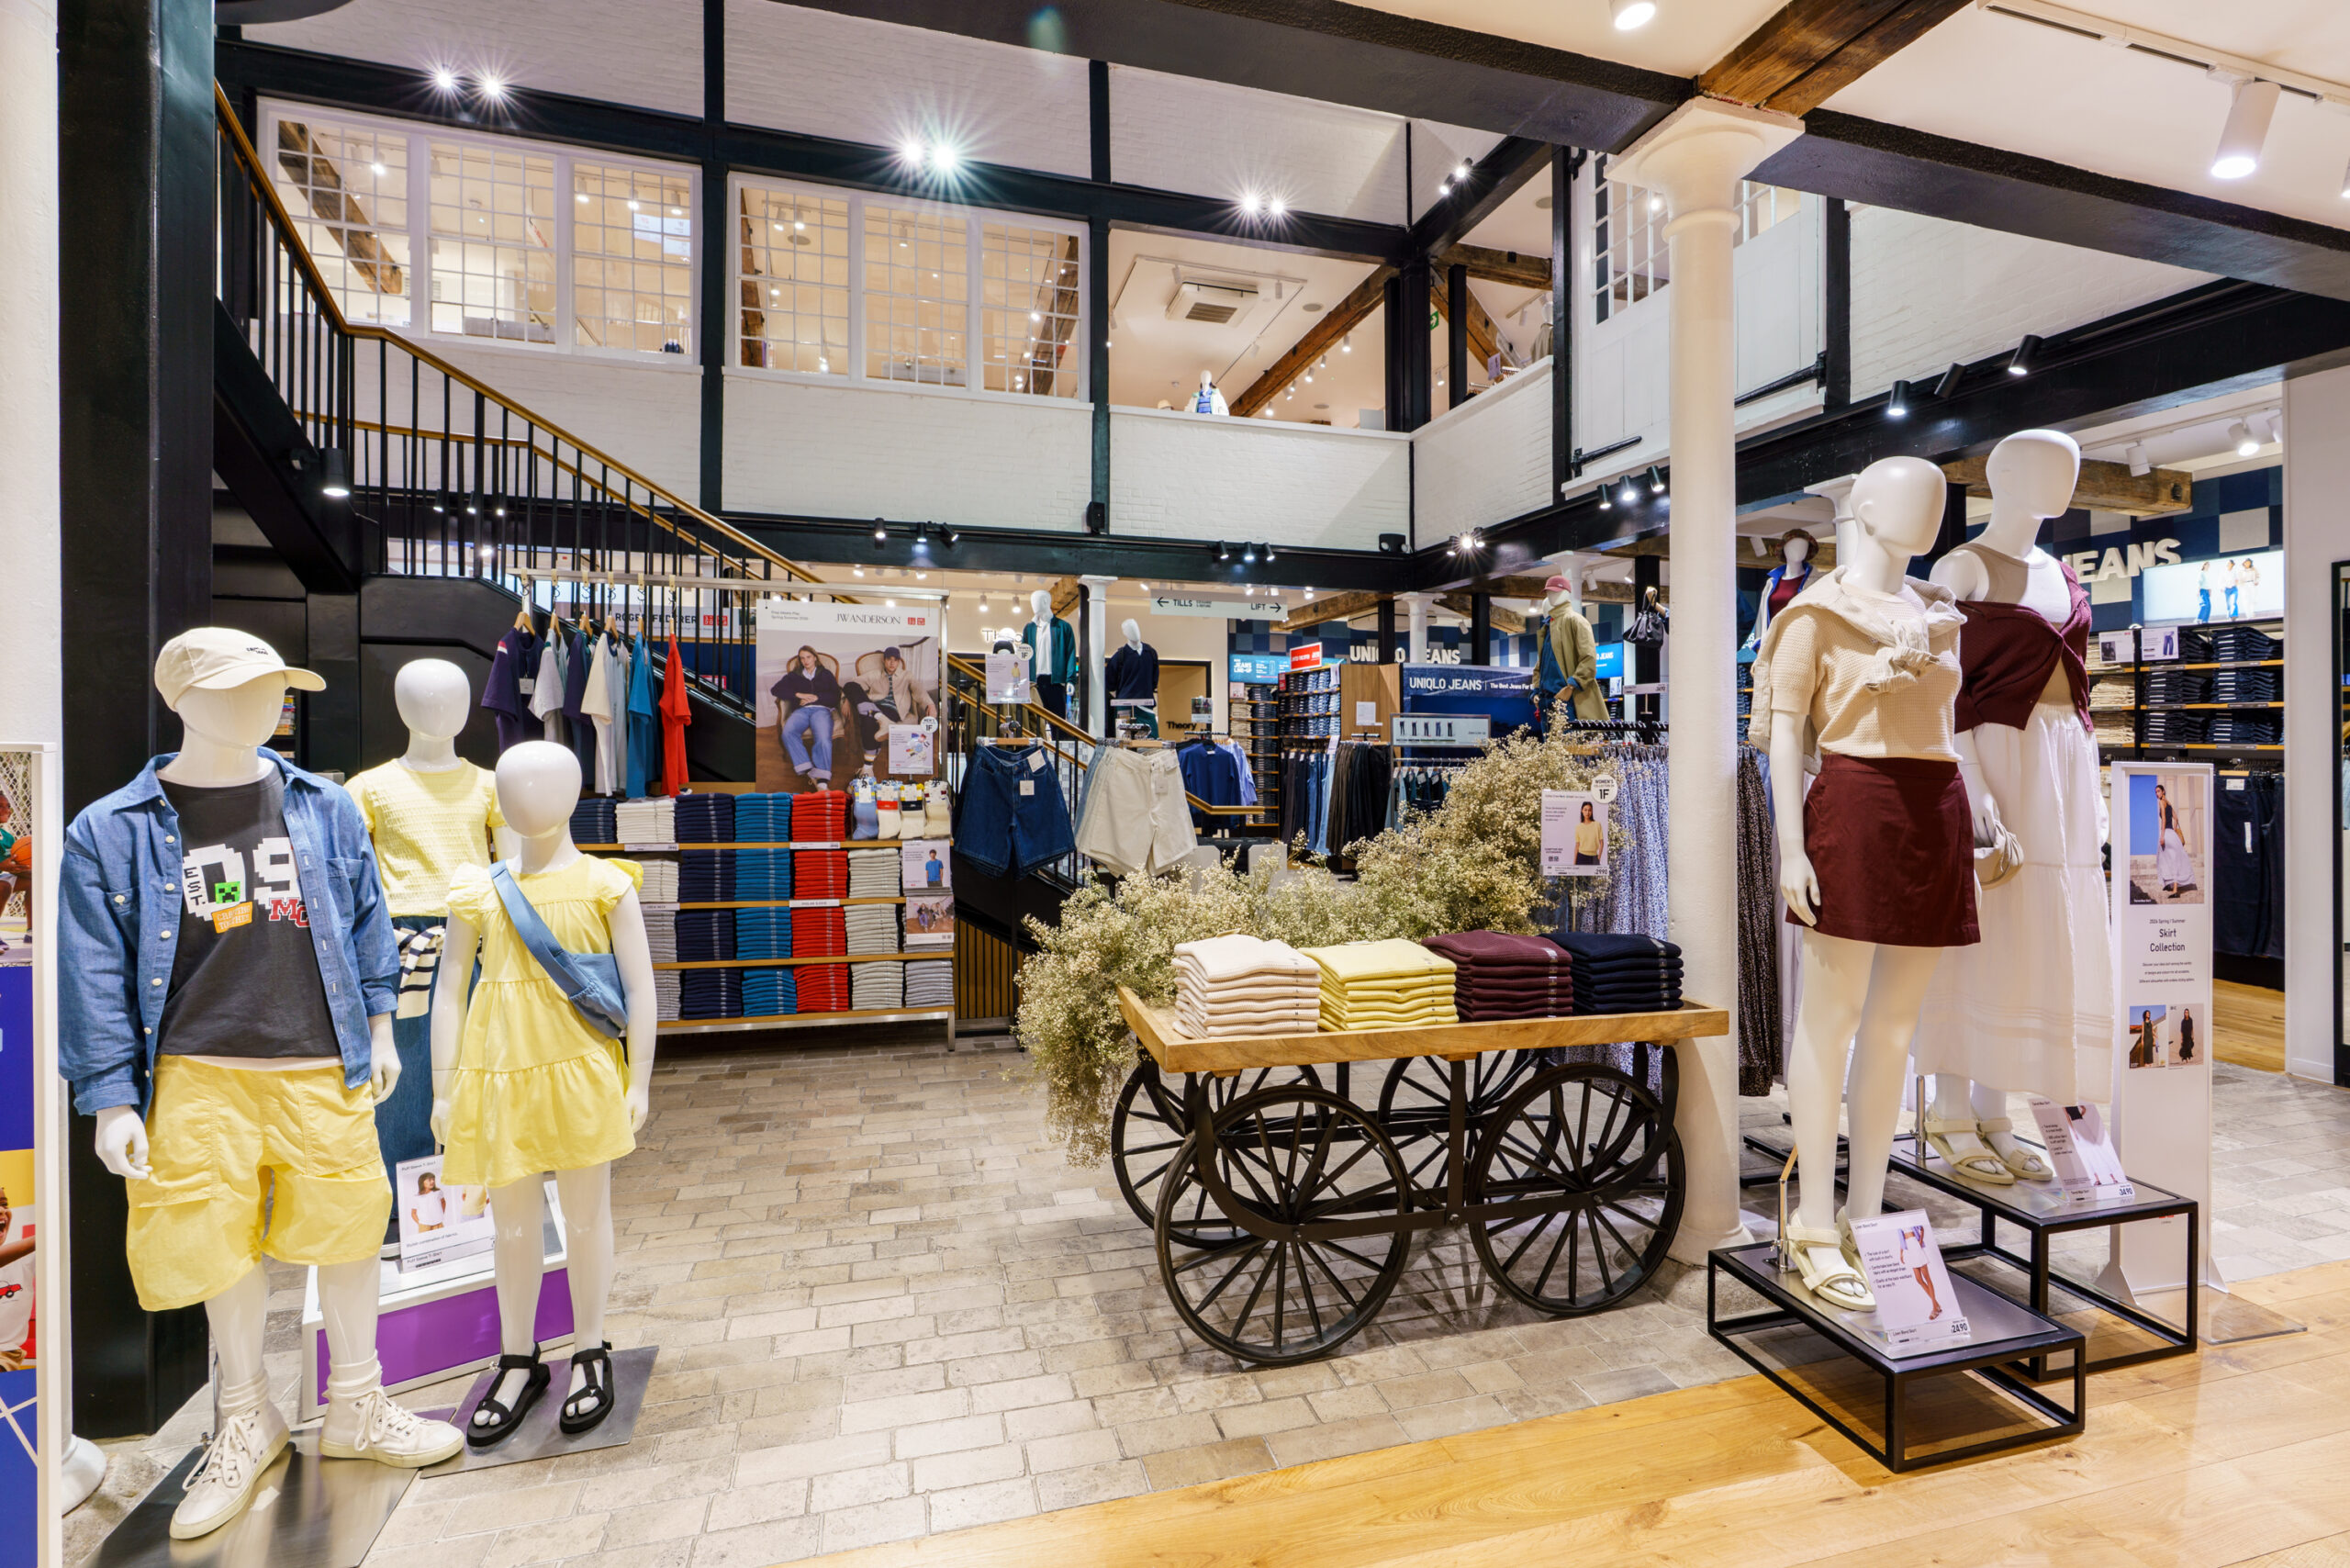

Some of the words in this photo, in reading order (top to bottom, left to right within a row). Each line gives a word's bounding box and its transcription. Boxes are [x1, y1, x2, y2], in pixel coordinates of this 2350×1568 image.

[1173, 599, 1192, 608] TILLS
[1251, 603, 1266, 611] LIFT
[1349, 645, 1405, 663] UNIO
[1426, 648, 1461, 665] EANS
[1409, 677, 1446, 689] UNIQLO
[1448, 678, 1483, 691] JEANS
[1166, 721, 1197, 731] Theory
[1599, 789, 1609, 799] 1F
[2159, 928, 2177, 938] Skirt
[2149, 942, 2185, 952] Collection
